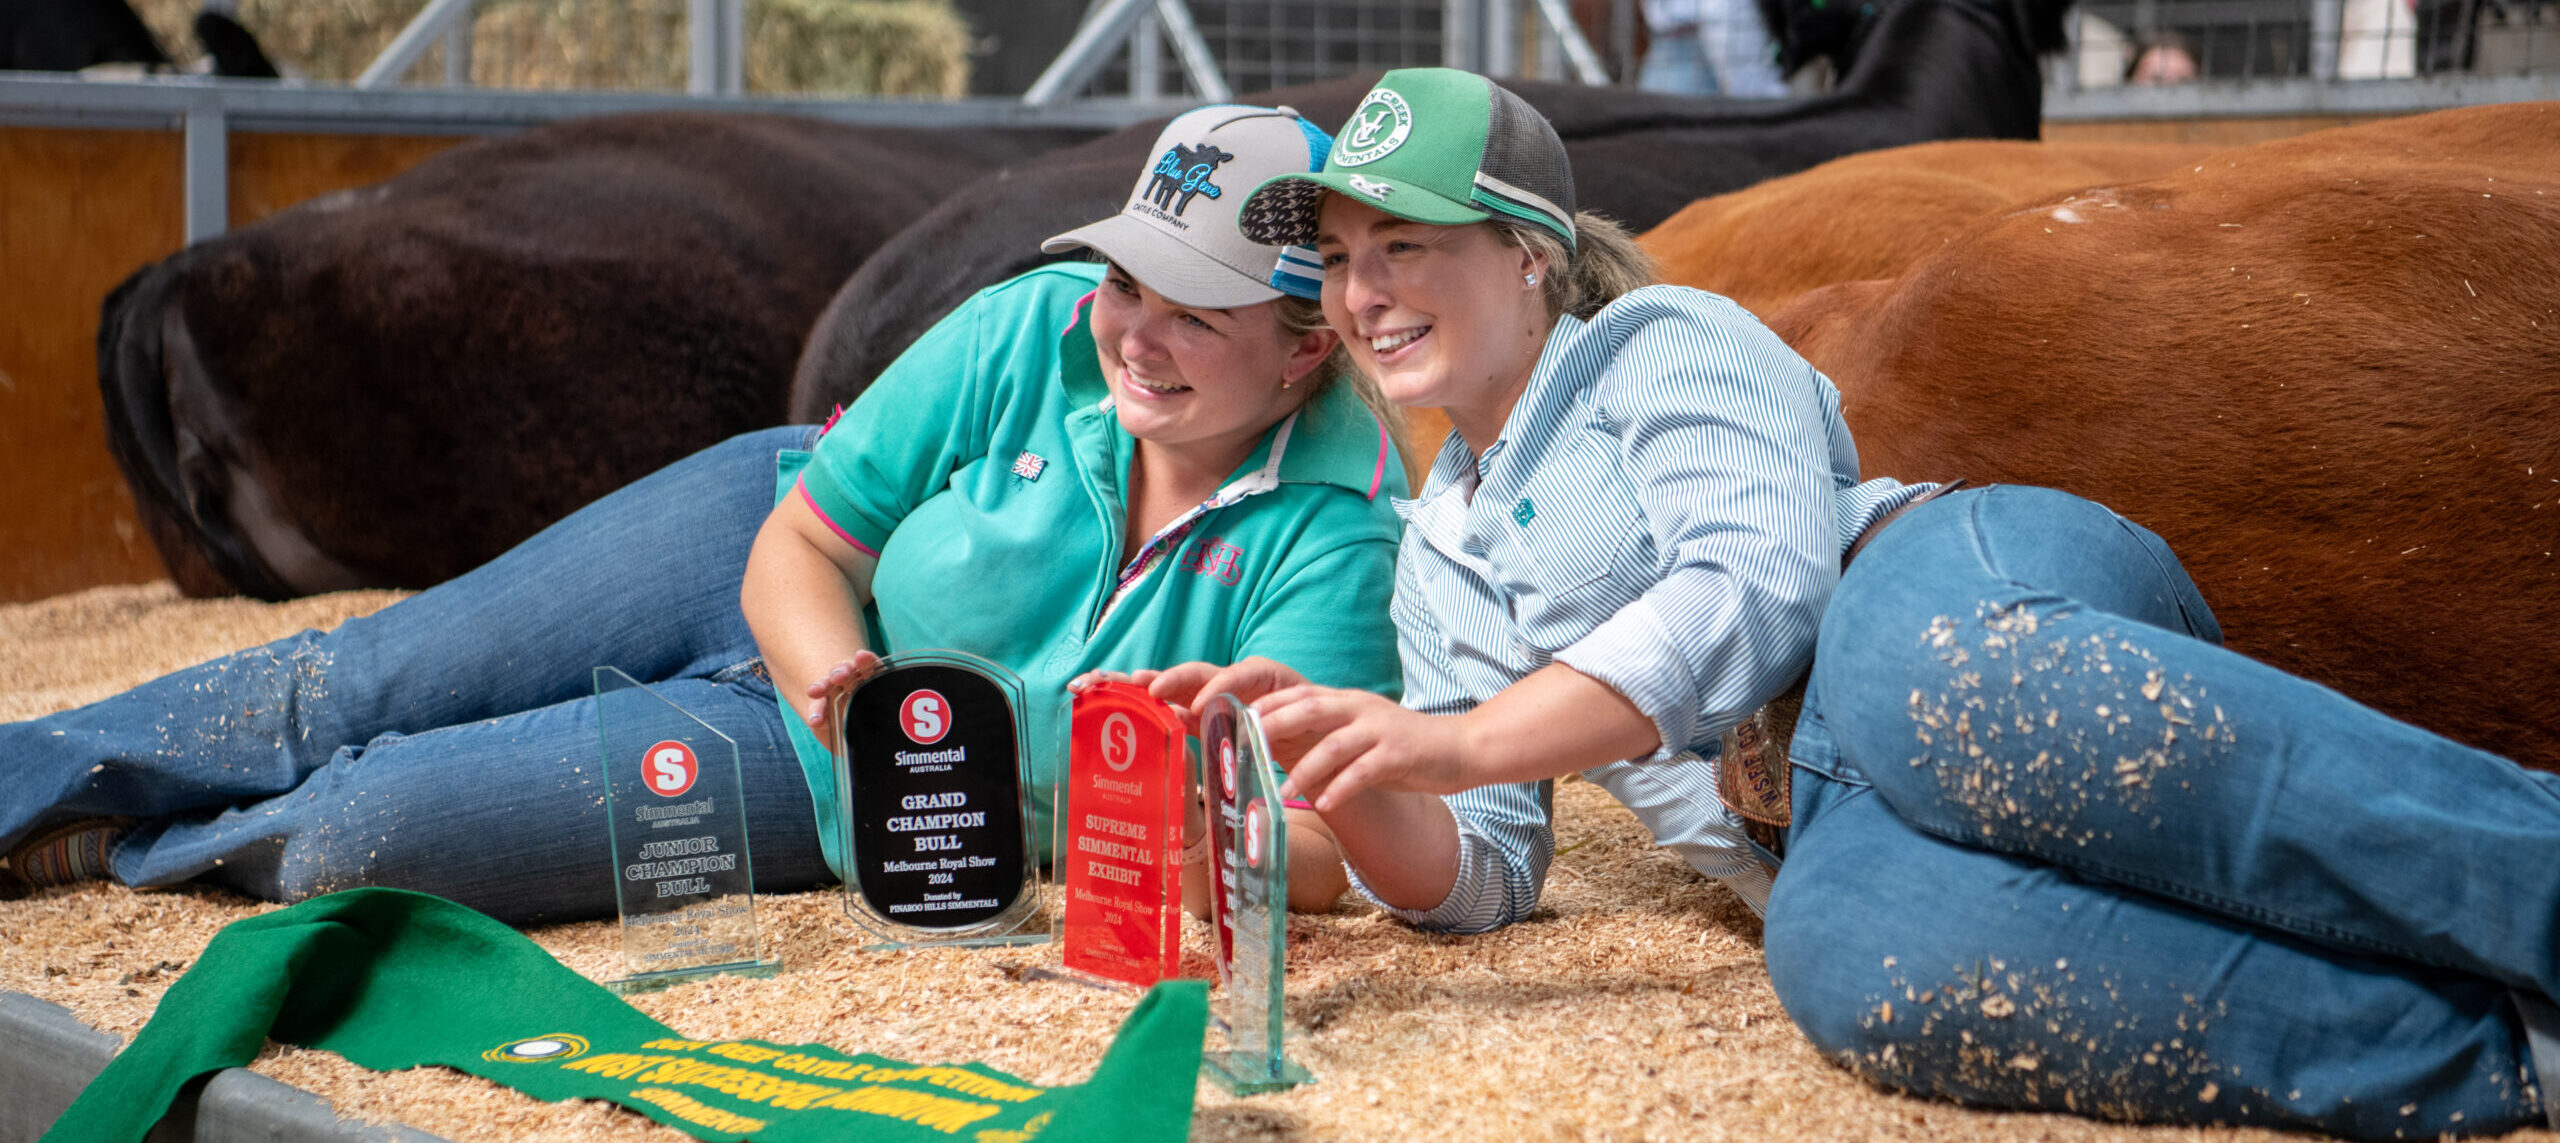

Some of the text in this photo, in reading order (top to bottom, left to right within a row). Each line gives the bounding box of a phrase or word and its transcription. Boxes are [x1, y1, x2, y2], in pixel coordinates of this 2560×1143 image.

[1380, 92, 1409, 127] CREEK
[1154, 150, 1222, 198] Blue Gene
[1132, 203, 1190, 231] CATTLE COMPANY
[894, 745, 967, 766] Simmental
[909, 764, 952, 774] AUSTRALIA
[1093, 774, 1143, 797] Simmental
[635, 797, 714, 821] Simmental
[901, 791, 967, 810] GRAND
[886, 811, 986, 832] CHAMPION
[1085, 814, 1147, 840] SUPREME
[639, 836, 719, 860] JUNIOR
[914, 834, 963, 852] BULL
[1078, 836, 1153, 865] SIMMENTAL
[625, 854, 736, 881] CHAMPION
[883, 856, 997, 873] Melbourne Royal Show
[1088, 861, 1142, 886] EXHIBIT
[656, 877, 711, 898] BULL
[928, 873, 954, 885] 2024
[923, 891, 962, 901] Donated by
[924, 901, 947, 912] HILLS
[947, 899, 999, 910] SIMMENTALS
[1074, 887, 1154, 915] Melbourne Royal Show
[623, 910, 683, 927] Melbourne
[1104, 911, 1122, 925] 2024
[673, 925, 700, 937] 2024
[706, 1042, 786, 1063] BEEF
[773, 1054, 874, 1081] CATTLE
